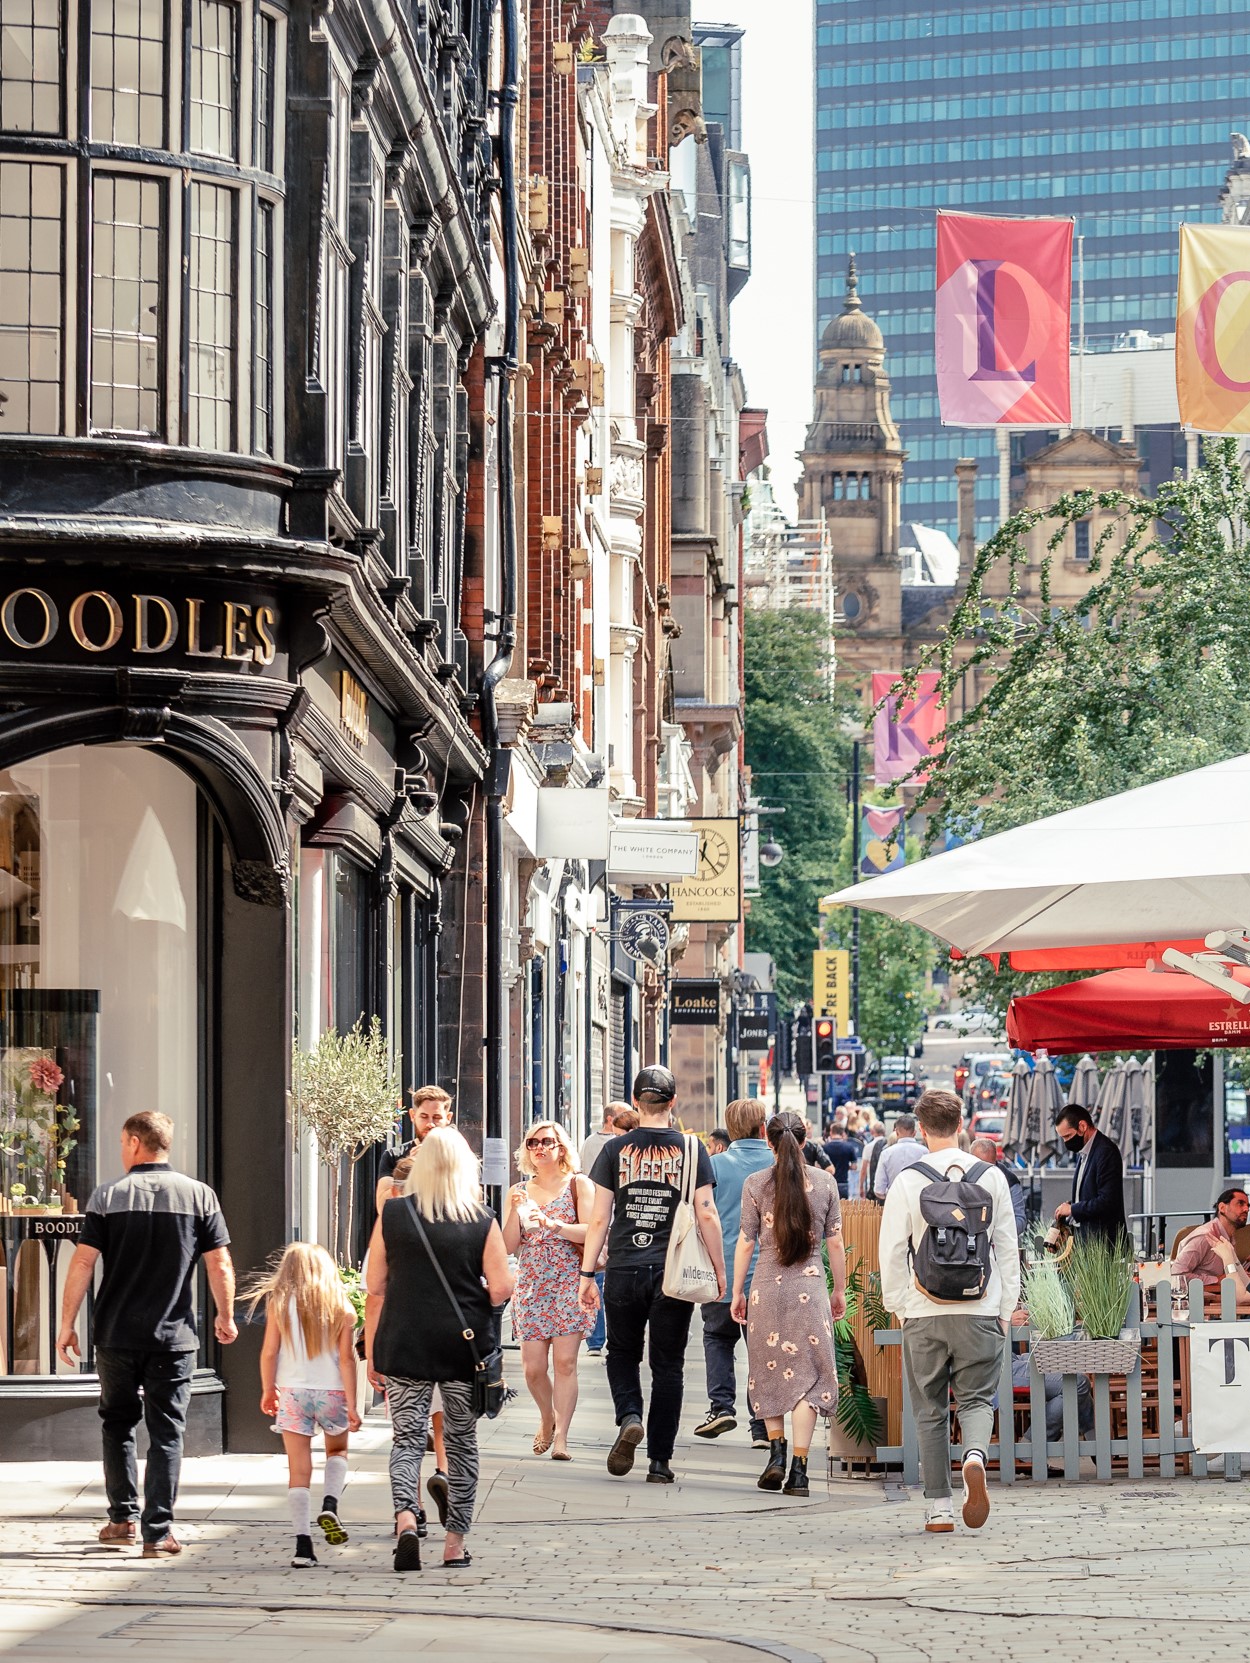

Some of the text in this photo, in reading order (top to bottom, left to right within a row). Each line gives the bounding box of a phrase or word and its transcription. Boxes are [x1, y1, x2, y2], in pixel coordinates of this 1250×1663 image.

[885, 692, 935, 762] K
[613, 845, 694, 856] THE WHITE COMPANY
[672, 886, 736, 897] HANCOCKS
[826, 956, 838, 988] BACK
[674, 996, 717, 1008] Loake
[618, 1143, 684, 1192] SLEEPS
[35, 1222, 84, 1234] BOODL
